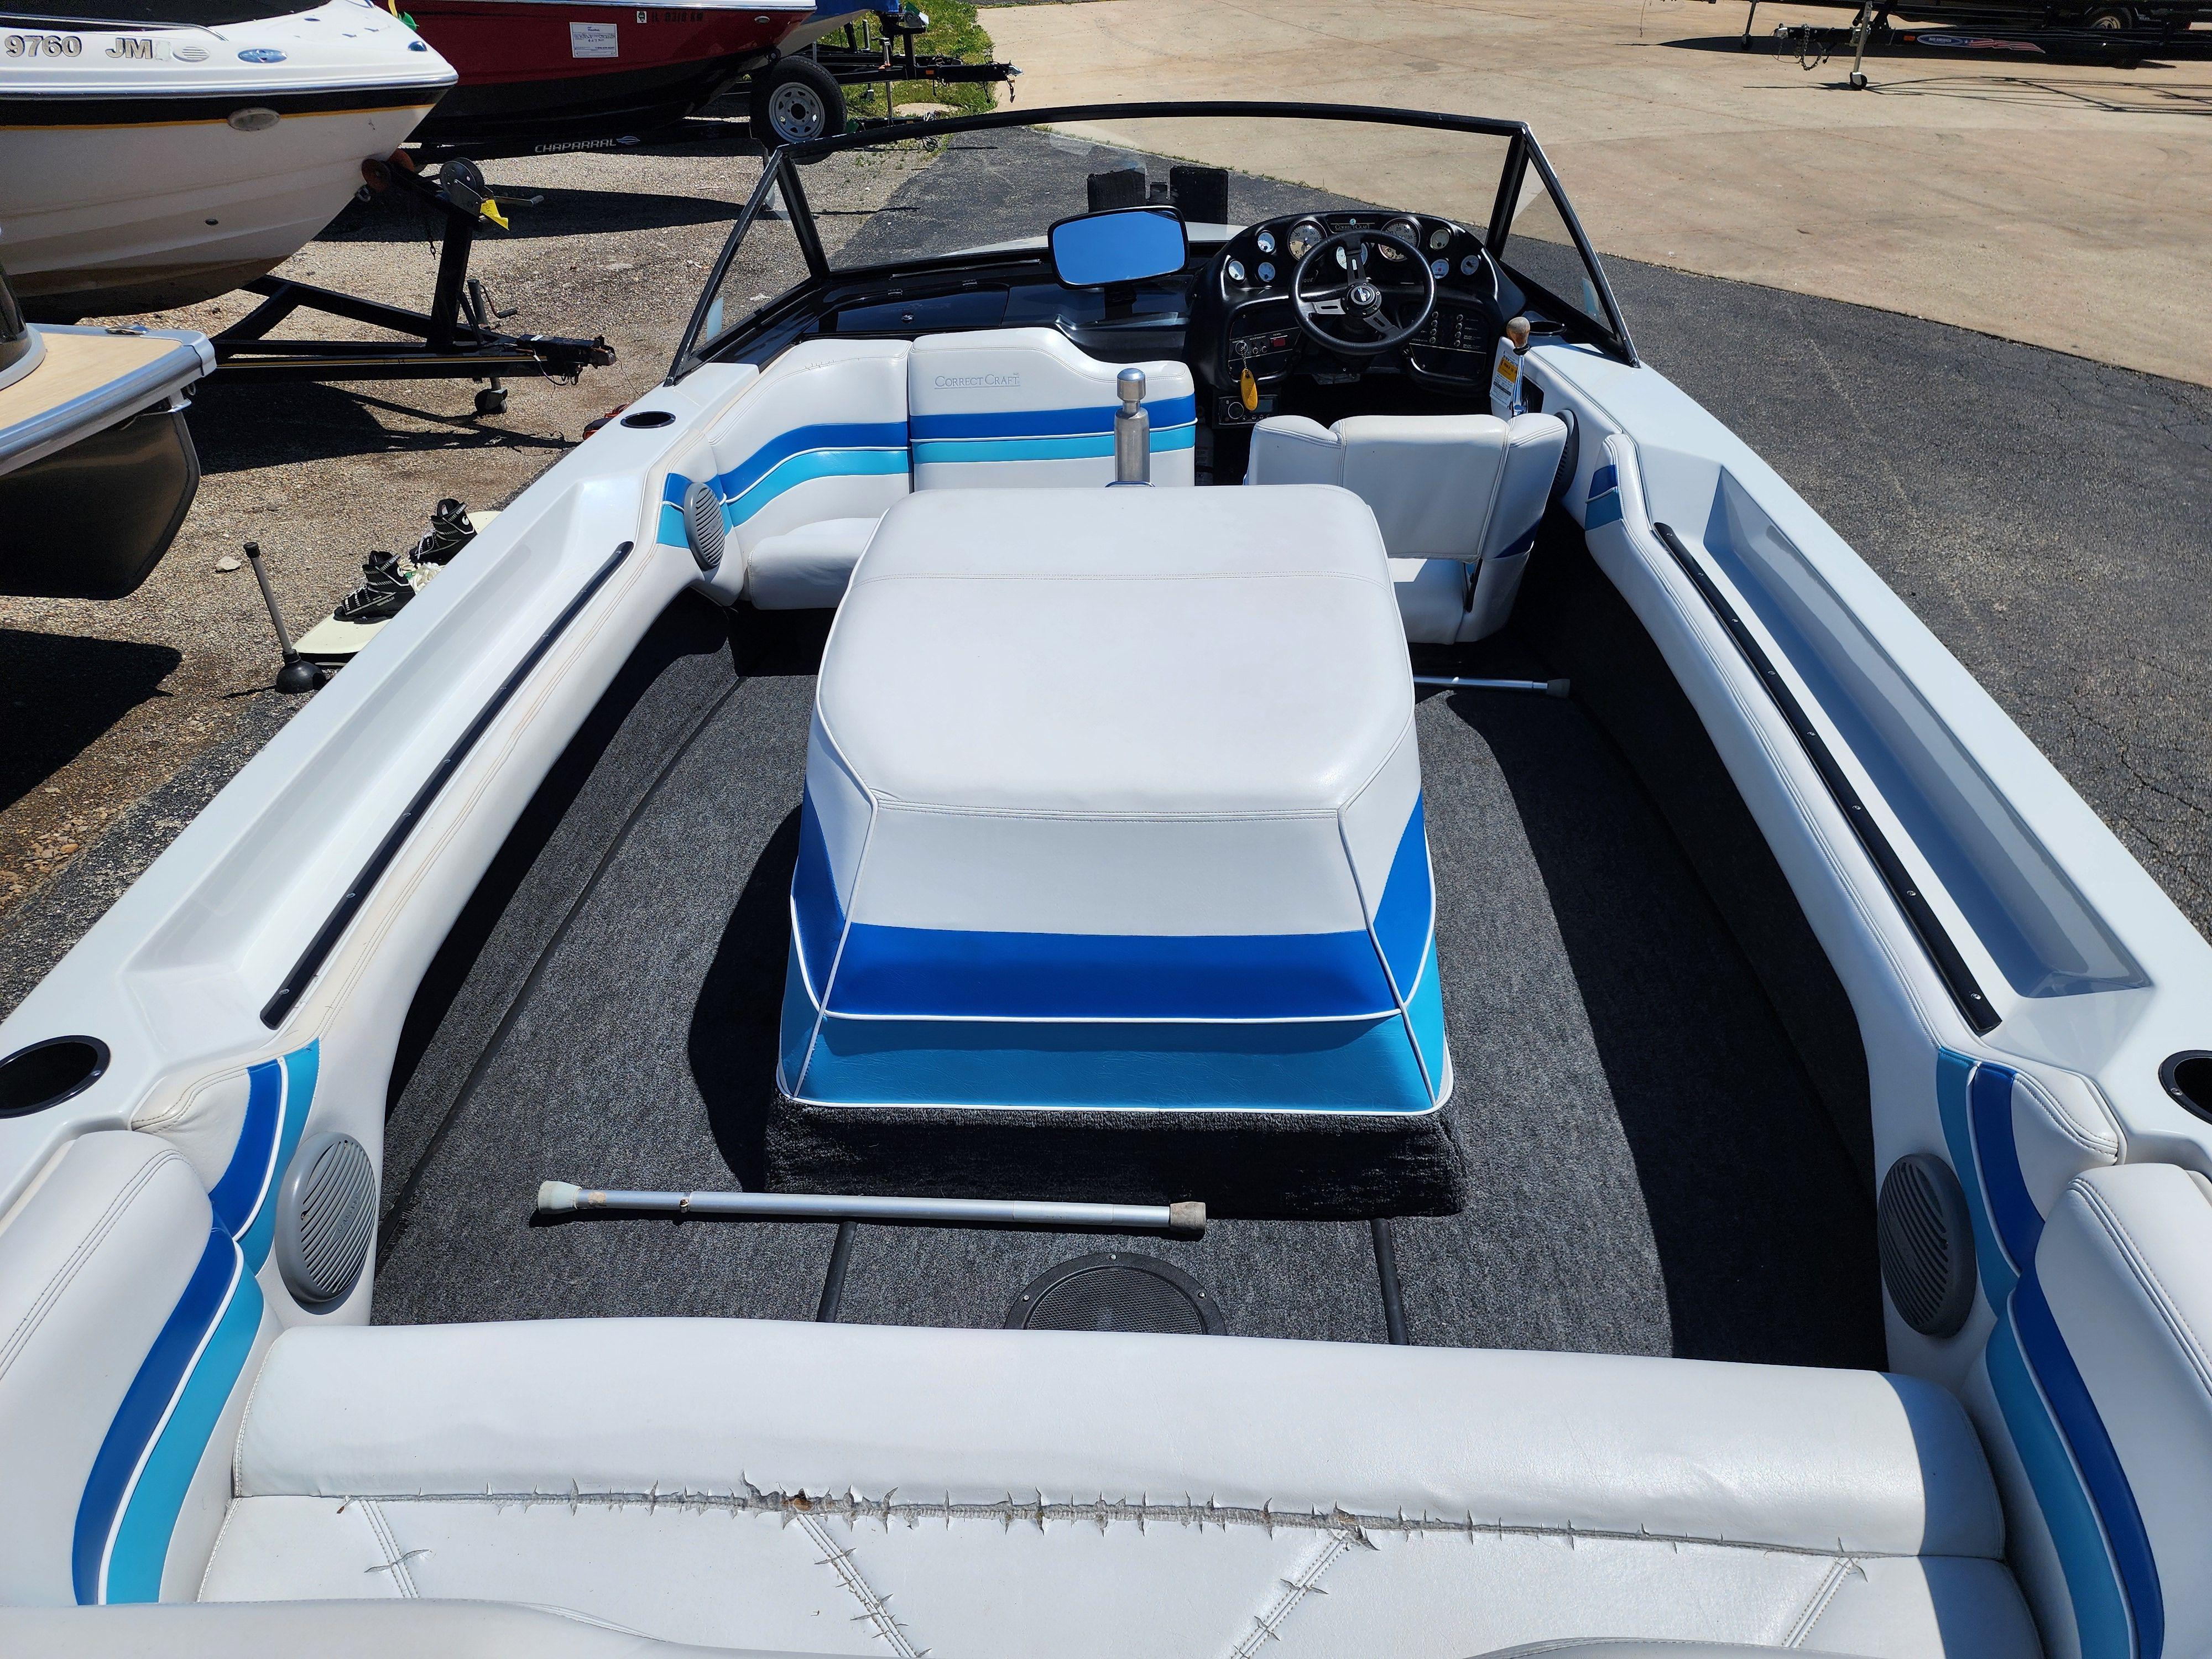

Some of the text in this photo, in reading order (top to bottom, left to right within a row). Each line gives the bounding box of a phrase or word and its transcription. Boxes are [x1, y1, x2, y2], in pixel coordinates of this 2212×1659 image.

[4, 35, 153, 60] 9760 JM
[535, 139, 617, 153] CHAPARRAL
[935, 375, 983, 387] CORRECT
[984, 374, 1020, 385] CRAFT
